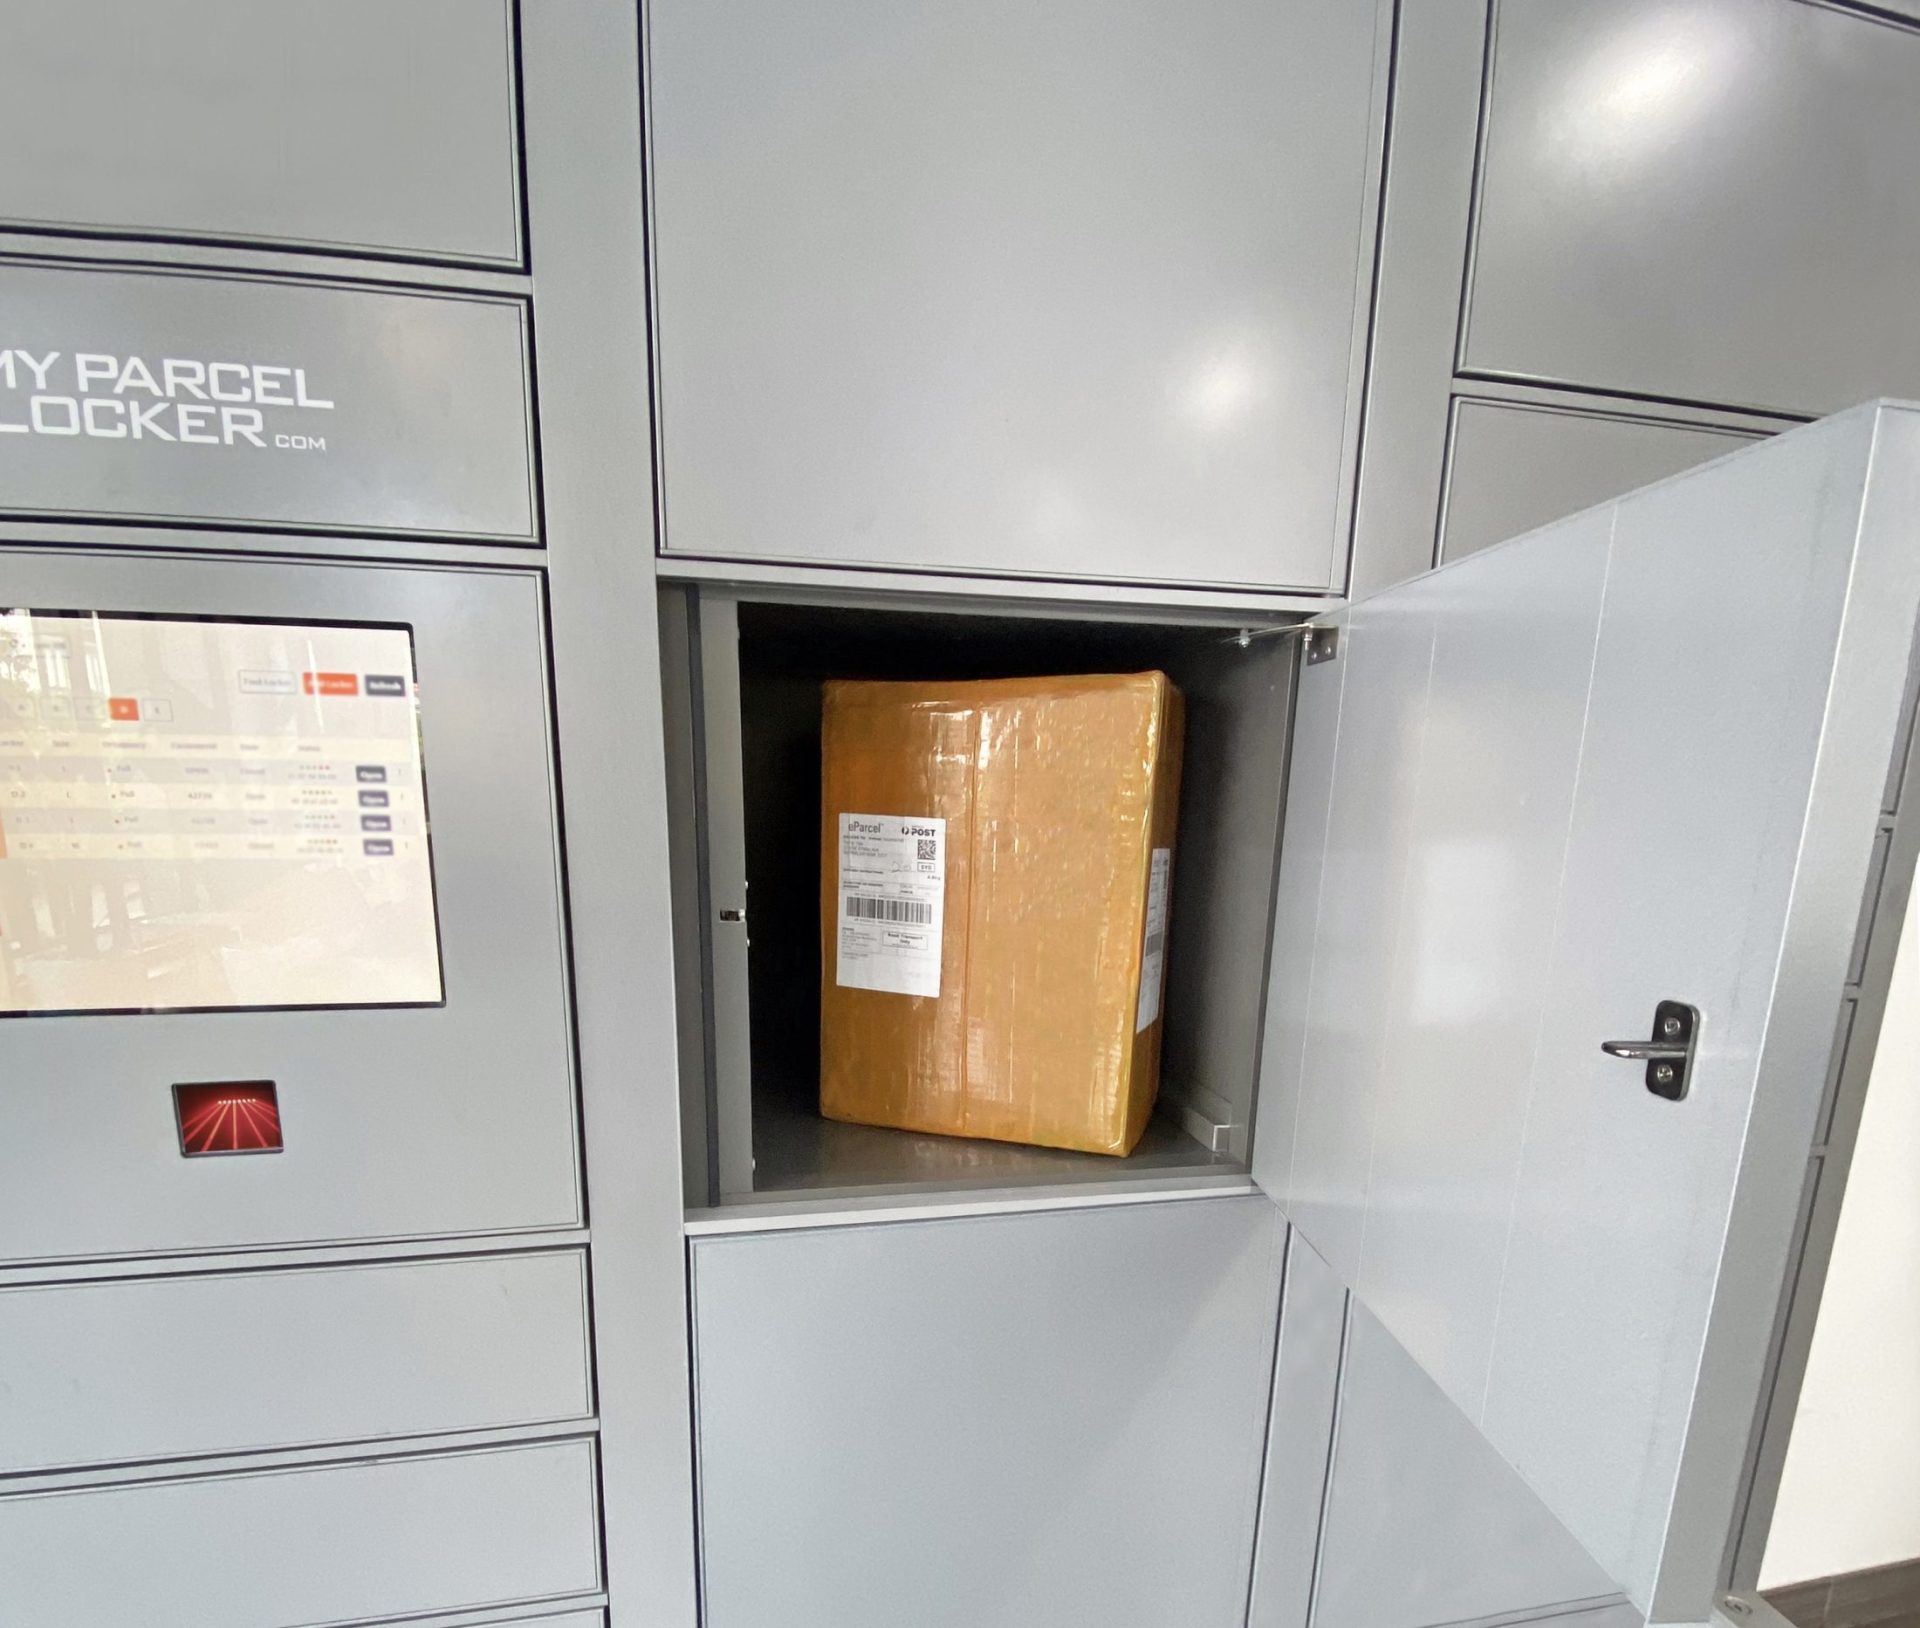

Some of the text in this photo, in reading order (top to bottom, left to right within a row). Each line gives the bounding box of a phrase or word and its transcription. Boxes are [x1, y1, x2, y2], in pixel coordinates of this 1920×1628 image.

[75, 353, 335, 409] PARCEL
[275, 434, 327, 451] COM
[911, 828, 936, 837] POST
